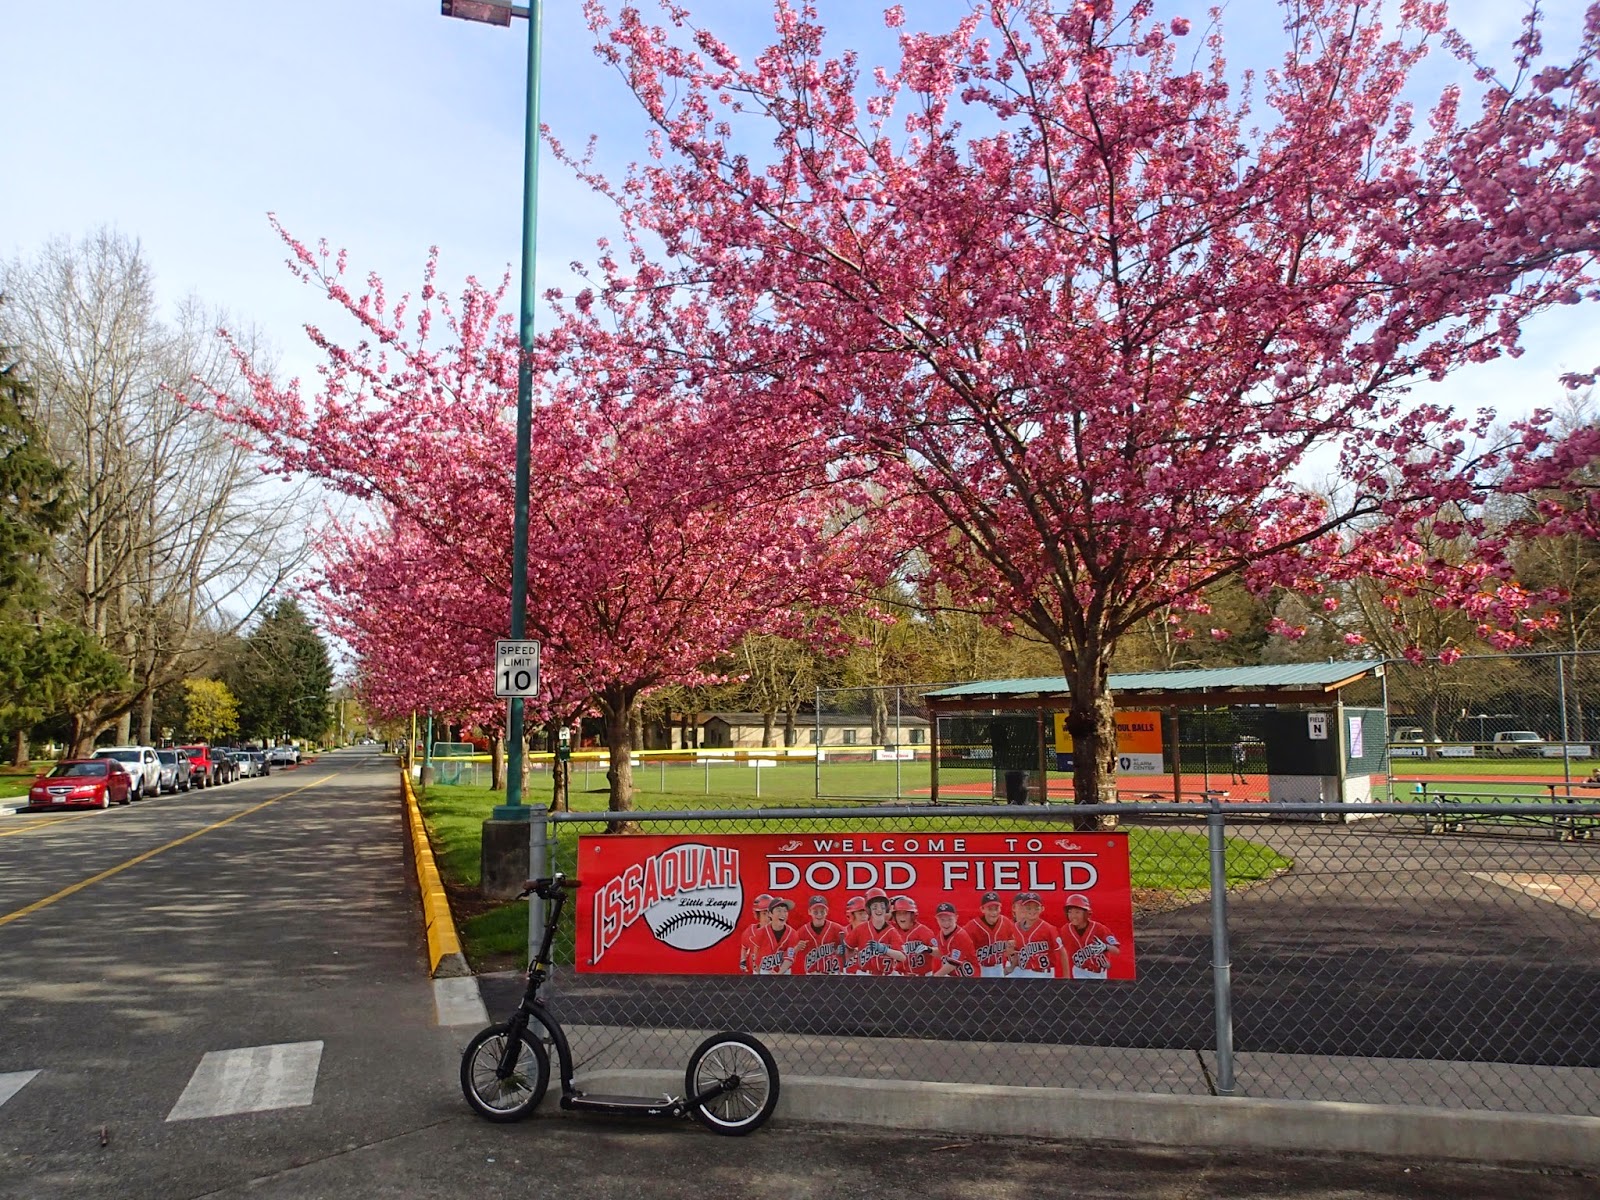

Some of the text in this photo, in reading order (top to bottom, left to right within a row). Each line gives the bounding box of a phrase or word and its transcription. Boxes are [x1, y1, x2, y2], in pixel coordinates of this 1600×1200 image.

[500, 646, 536, 655] SPEED
[503, 658, 531, 667] LIMIT
[503, 670, 531, 690] 10
[1117, 723, 1154, 732] OUL BALLS
[1313, 724, 1322, 733] N
[813, 838, 1044, 853] WELCOME TO
[768, 860, 1099, 891] DODD FIELD
[592, 847, 741, 966] ISSAQUAH
[678, 897, 738, 910] Little League
[825, 957, 840, 973] 12
[882, 957, 893, 974] 7
[910, 953, 926, 969] 13
[1038, 954, 1050, 970] 8
